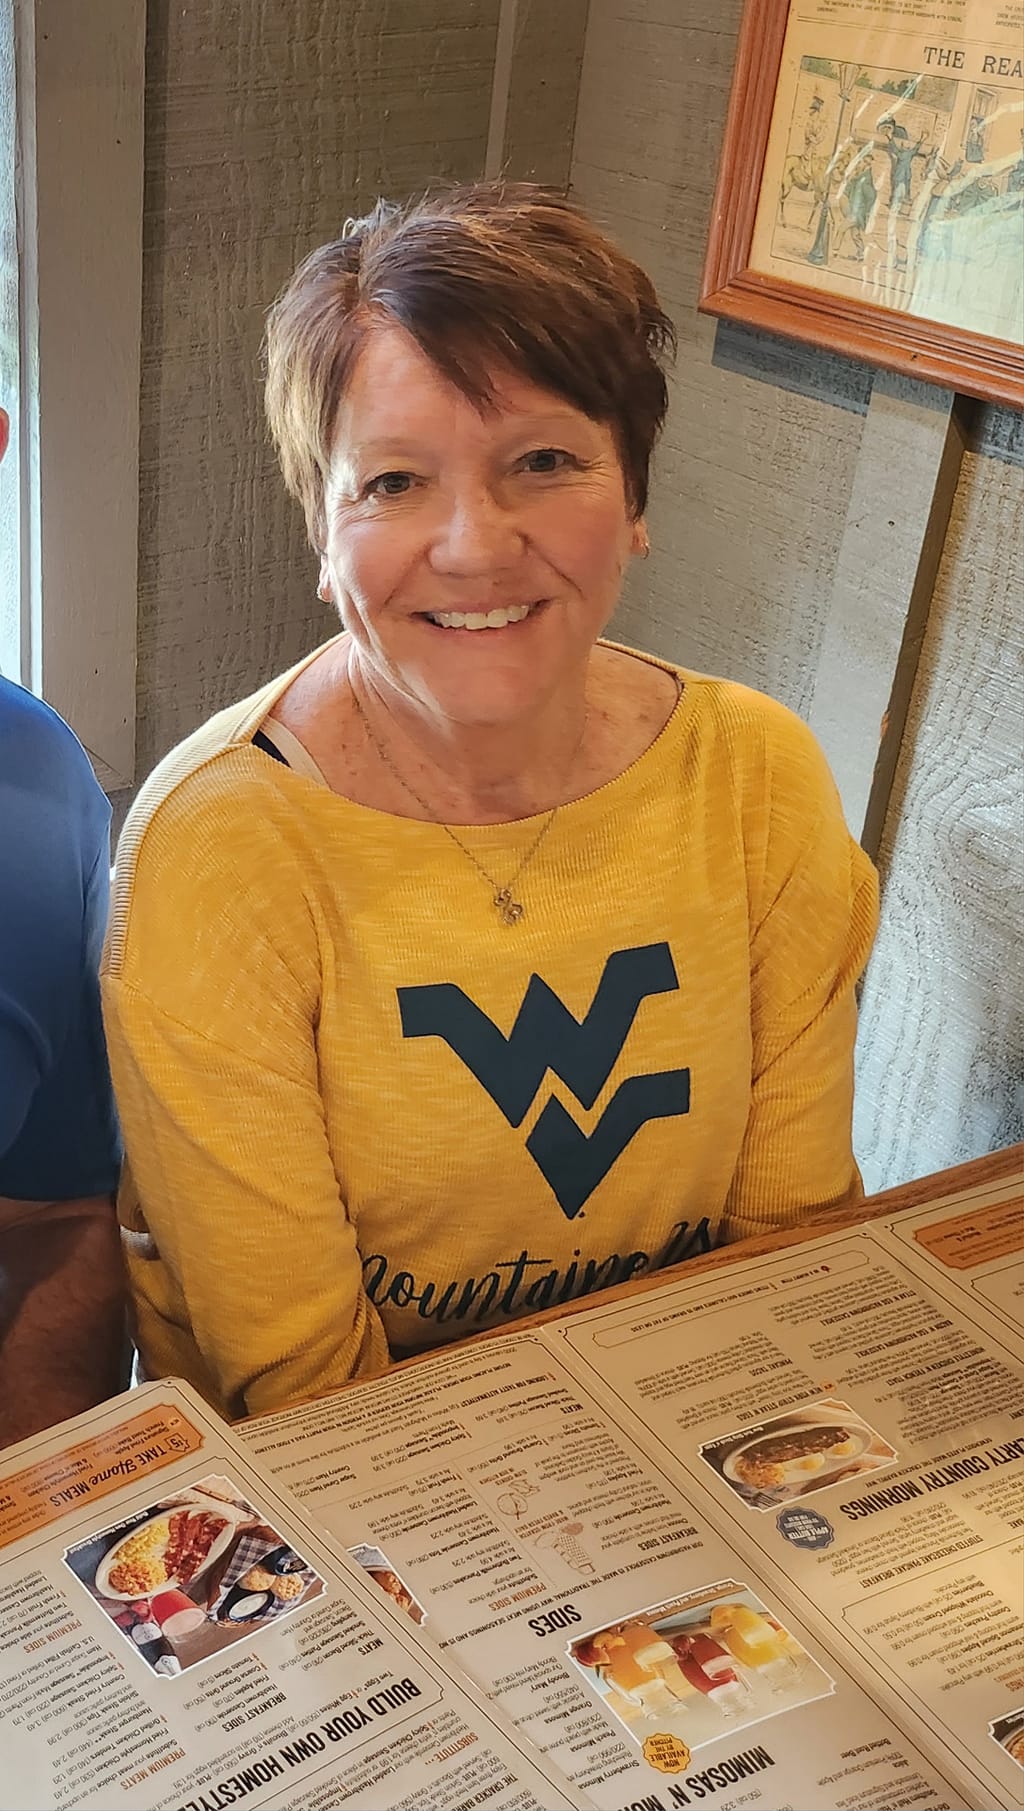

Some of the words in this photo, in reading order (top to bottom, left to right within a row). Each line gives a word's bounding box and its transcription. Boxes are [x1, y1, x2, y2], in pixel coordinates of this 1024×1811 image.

[924, 46, 965, 70] THE
[560, 1403, 583, 1414] MEATS
[134, 1445, 167, 1465] TAKE
[86, 1459, 134, 1491] Home
[919, 1456, 989, 1491] COUNTRY
[49, 1481, 90, 1506] MEALS
[840, 1481, 923, 1520] MORNINGS
[659, 1527, 698, 1544] BREAKFAST
[637, 1538, 660, 1551] SIDES
[510, 1582, 547, 1602] PREMIUM
[488, 1597, 512, 1611] SIDES
[528, 1605, 581, 1636] SIDES
[46, 1619, 82, 1642] PREMIUM
[23, 1638, 47, 1653] SIDES
[358, 1638, 383, 1655] MEATS
[240, 1665, 261, 1678] Coarse
[253, 1674, 269, 1686] Fried
[379, 1671, 394, 1680] Two
[547, 1672, 570, 1684] Bloody
[100, 1674, 125, 1688] Country
[219, 1676, 241, 1691] Ground
[234, 1682, 254, 1695] Apples
[84, 1686, 102, 1698] Fried
[205, 1688, 221, 1697] Grits
[244, 1683, 278, 1704] Hashbrown
[367, 1678, 421, 1715] BUILD
[67, 1695, 86, 1707] Steak
[245, 1692, 286, 1720] BREAKFAST
[569, 1701, 592, 1713] Orange
[118, 1707, 152, 1728] Hamburger
[217, 1701, 246, 1719] Casserole
[544, 1711, 570, 1724] Mimosa
[139, 1718, 160, 1733] Grilled
[222, 1715, 245, 1732] SIDES
[320, 1707, 372, 1742] YOUR
[115, 1729, 141, 1745] Chicken
[151, 1727, 169, 1741] Fried
[594, 1729, 616, 1742] Peach
[90, 1744, 116, 1759] Tenders
[120, 1737, 153, 1757] Homestyle
[279, 1732, 325, 1766] OWN
[434, 1732, 478, 1762] SUBSTITUTE
[570, 1739, 596, 1752] Mimosa
[94, 1755, 120, 1772] Chicken
[147, 1748, 185, 1774] PREMIUM
[649, 1750, 685, 1762] AVAILABLE
[663, 1758, 680, 1768] NOW
[603, 1760, 639, 1778] Strawberry
[686, 1747, 773, 1797] MIMOSAS
[120, 1769, 149, 1790] MEATS
[501, 1773, 518, 1786] THE
[578, 1776, 605, 1789] Mimosa
[473, 1781, 504, 1803] CRACKER
[667, 1784, 691, 1809] N'
